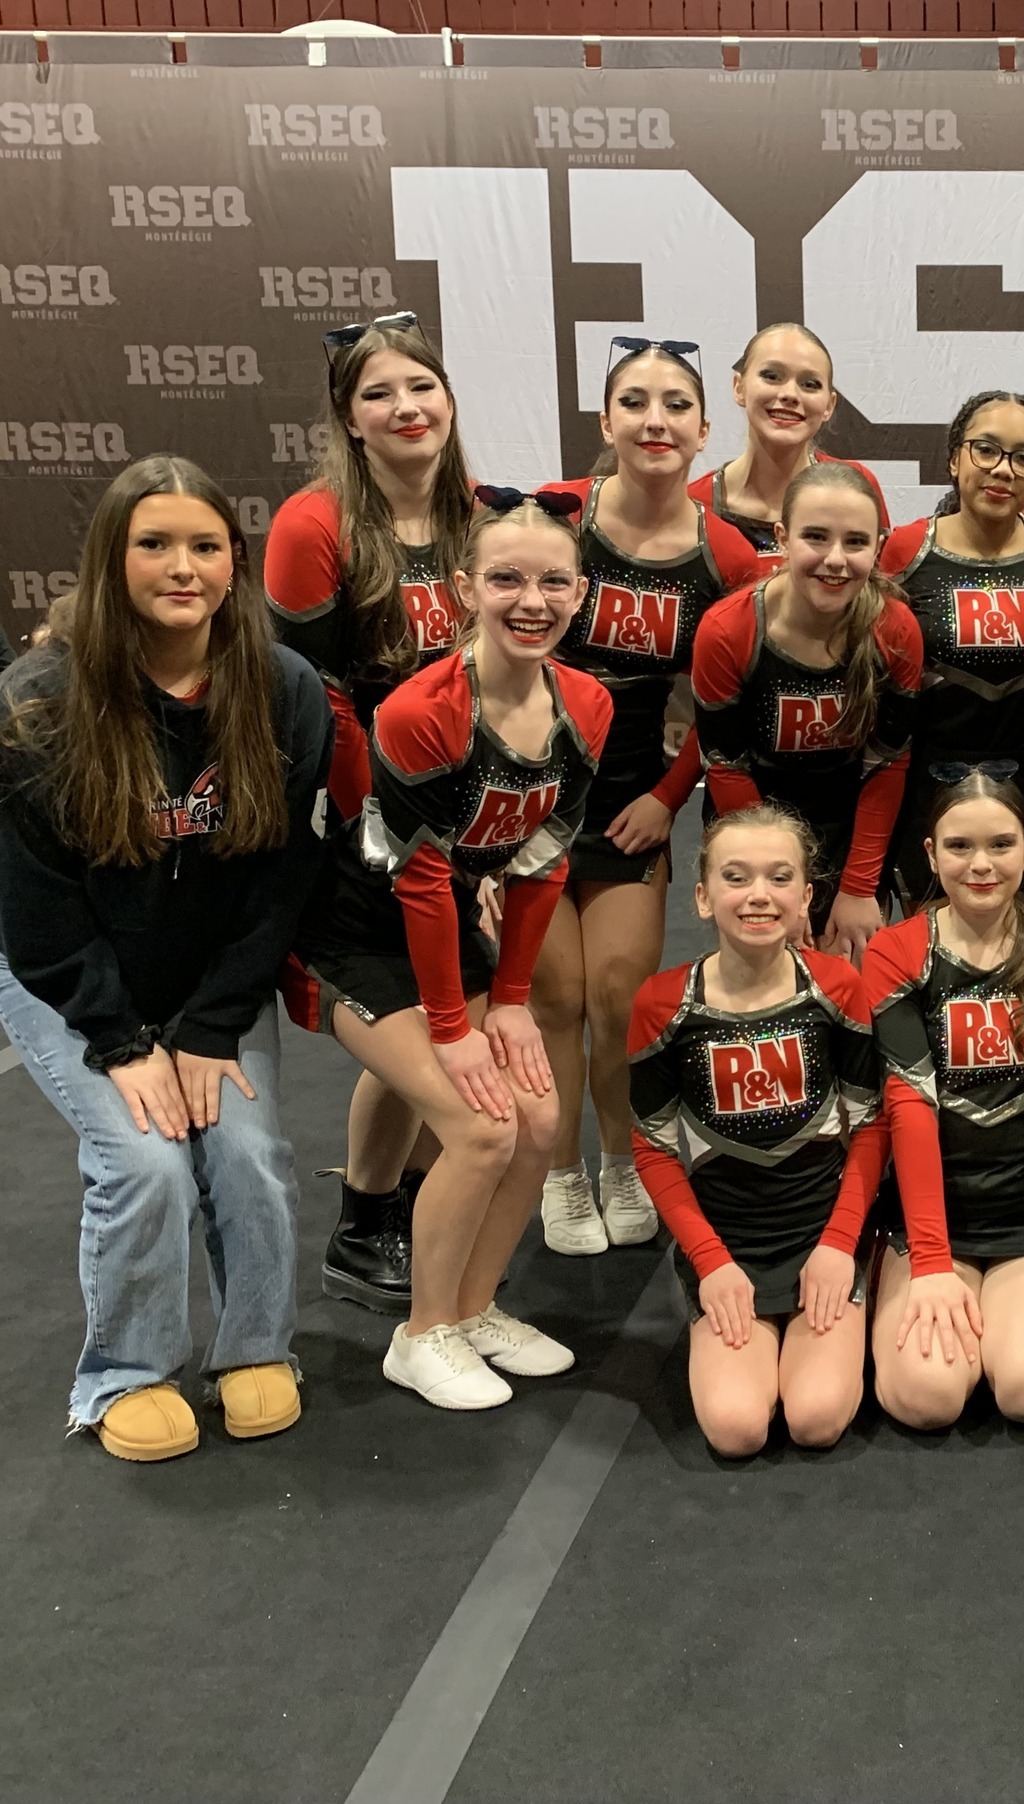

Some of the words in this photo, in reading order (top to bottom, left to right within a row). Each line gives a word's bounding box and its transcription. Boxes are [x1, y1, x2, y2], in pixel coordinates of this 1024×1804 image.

[0, 102, 101, 145] SEQ
[244, 104, 389, 148] RSEQ
[533, 106, 675, 149] RSEQ
[821, 109, 962, 151] RSEQ
[282, 150, 349, 162] MONTÉRÉGIE
[568, 152, 636, 164] MONTÉRÉGIE
[855, 154, 922, 166] MONTÉRÉGIE
[108, 185, 252, 227] RSEQ
[145, 230, 212, 242] MONTÉRÉGIE
[259, 266, 398, 307] RSEQ
[12, 308, 79, 320] MONTÉRÉGIE
[124, 345, 264, 385] RSEQ
[270, 423, 331, 463] RS
[8, 570, 79, 609] RS
[586, 581, 681, 659] R&N
[456, 780, 561, 848] R&N
[708, 1033, 807, 1115] R&N
